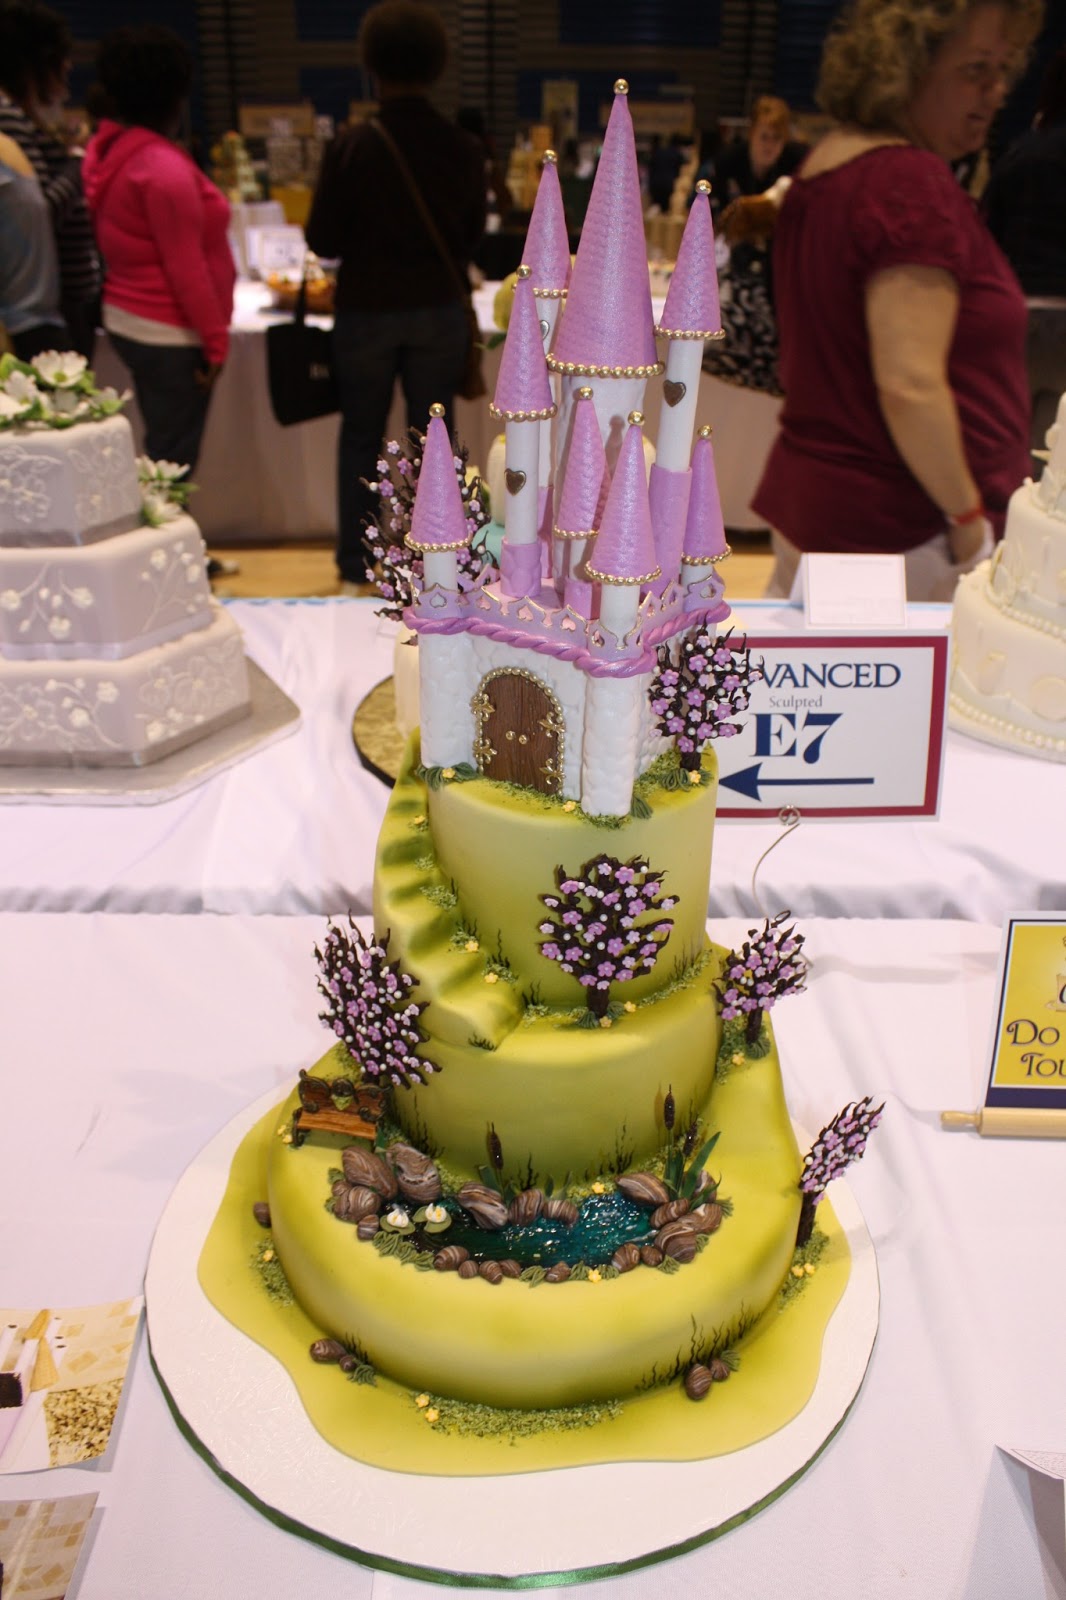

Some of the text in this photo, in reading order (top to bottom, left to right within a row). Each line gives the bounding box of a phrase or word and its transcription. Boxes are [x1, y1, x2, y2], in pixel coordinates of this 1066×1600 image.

[739, 662, 902, 688] VANCED
[768, 694, 824, 711] Sculpted
[748, 710, 844, 764] E7
